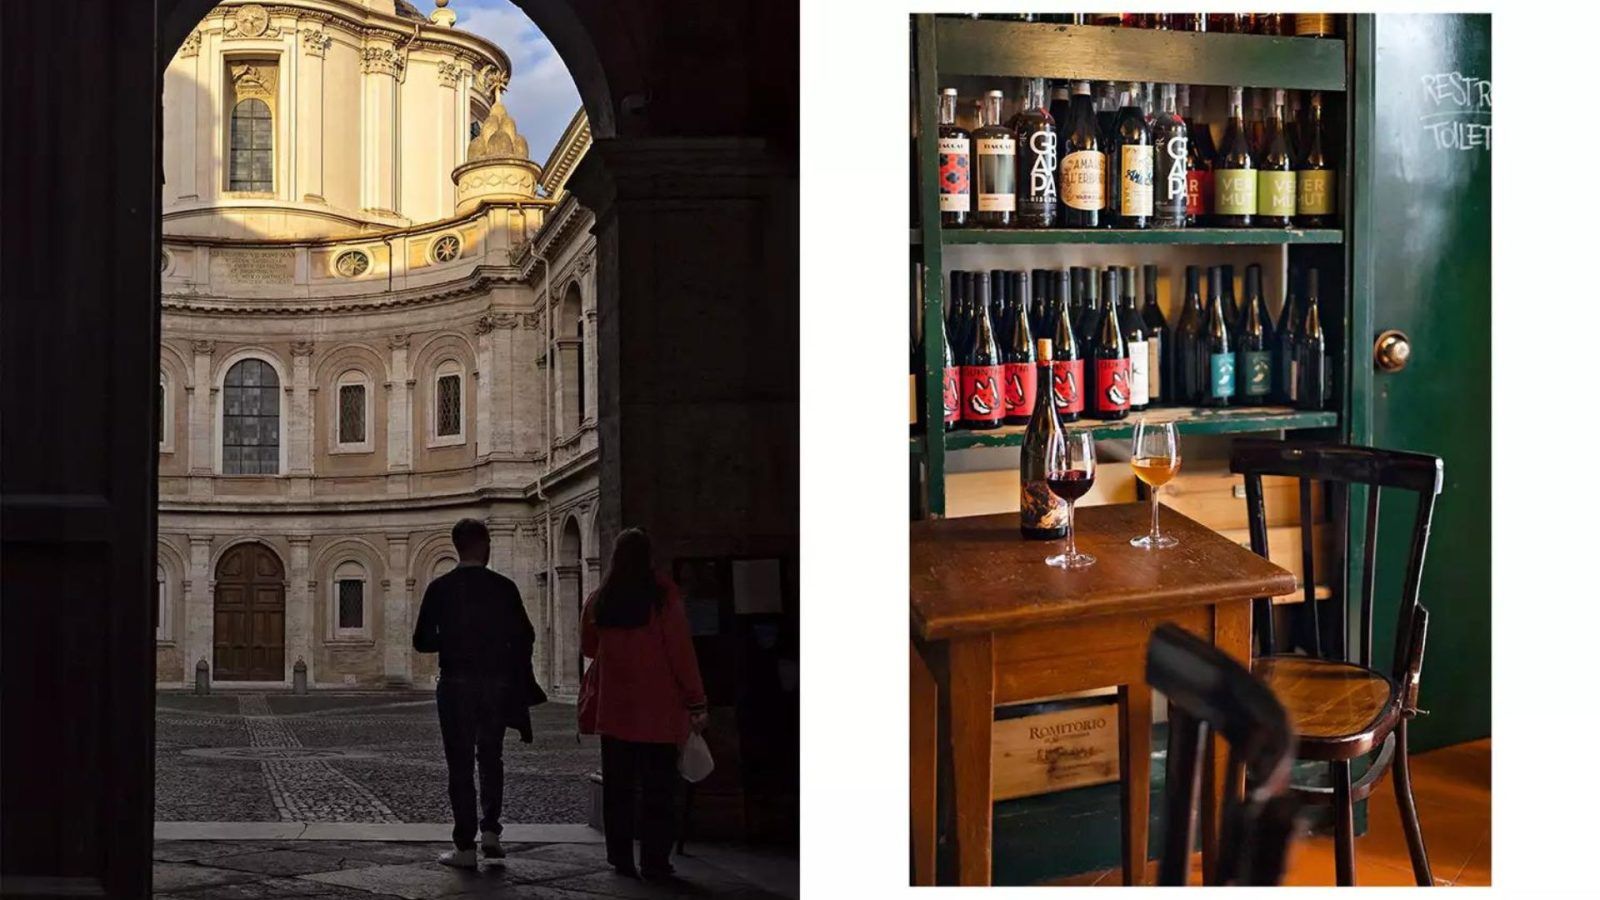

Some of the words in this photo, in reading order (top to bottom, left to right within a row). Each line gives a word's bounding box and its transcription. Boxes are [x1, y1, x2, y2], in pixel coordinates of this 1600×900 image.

[1423, 120, 1491, 151] TOILET
[1303, 178, 1325, 191] ER
[1029, 718, 1107, 740] ROMITORIO
